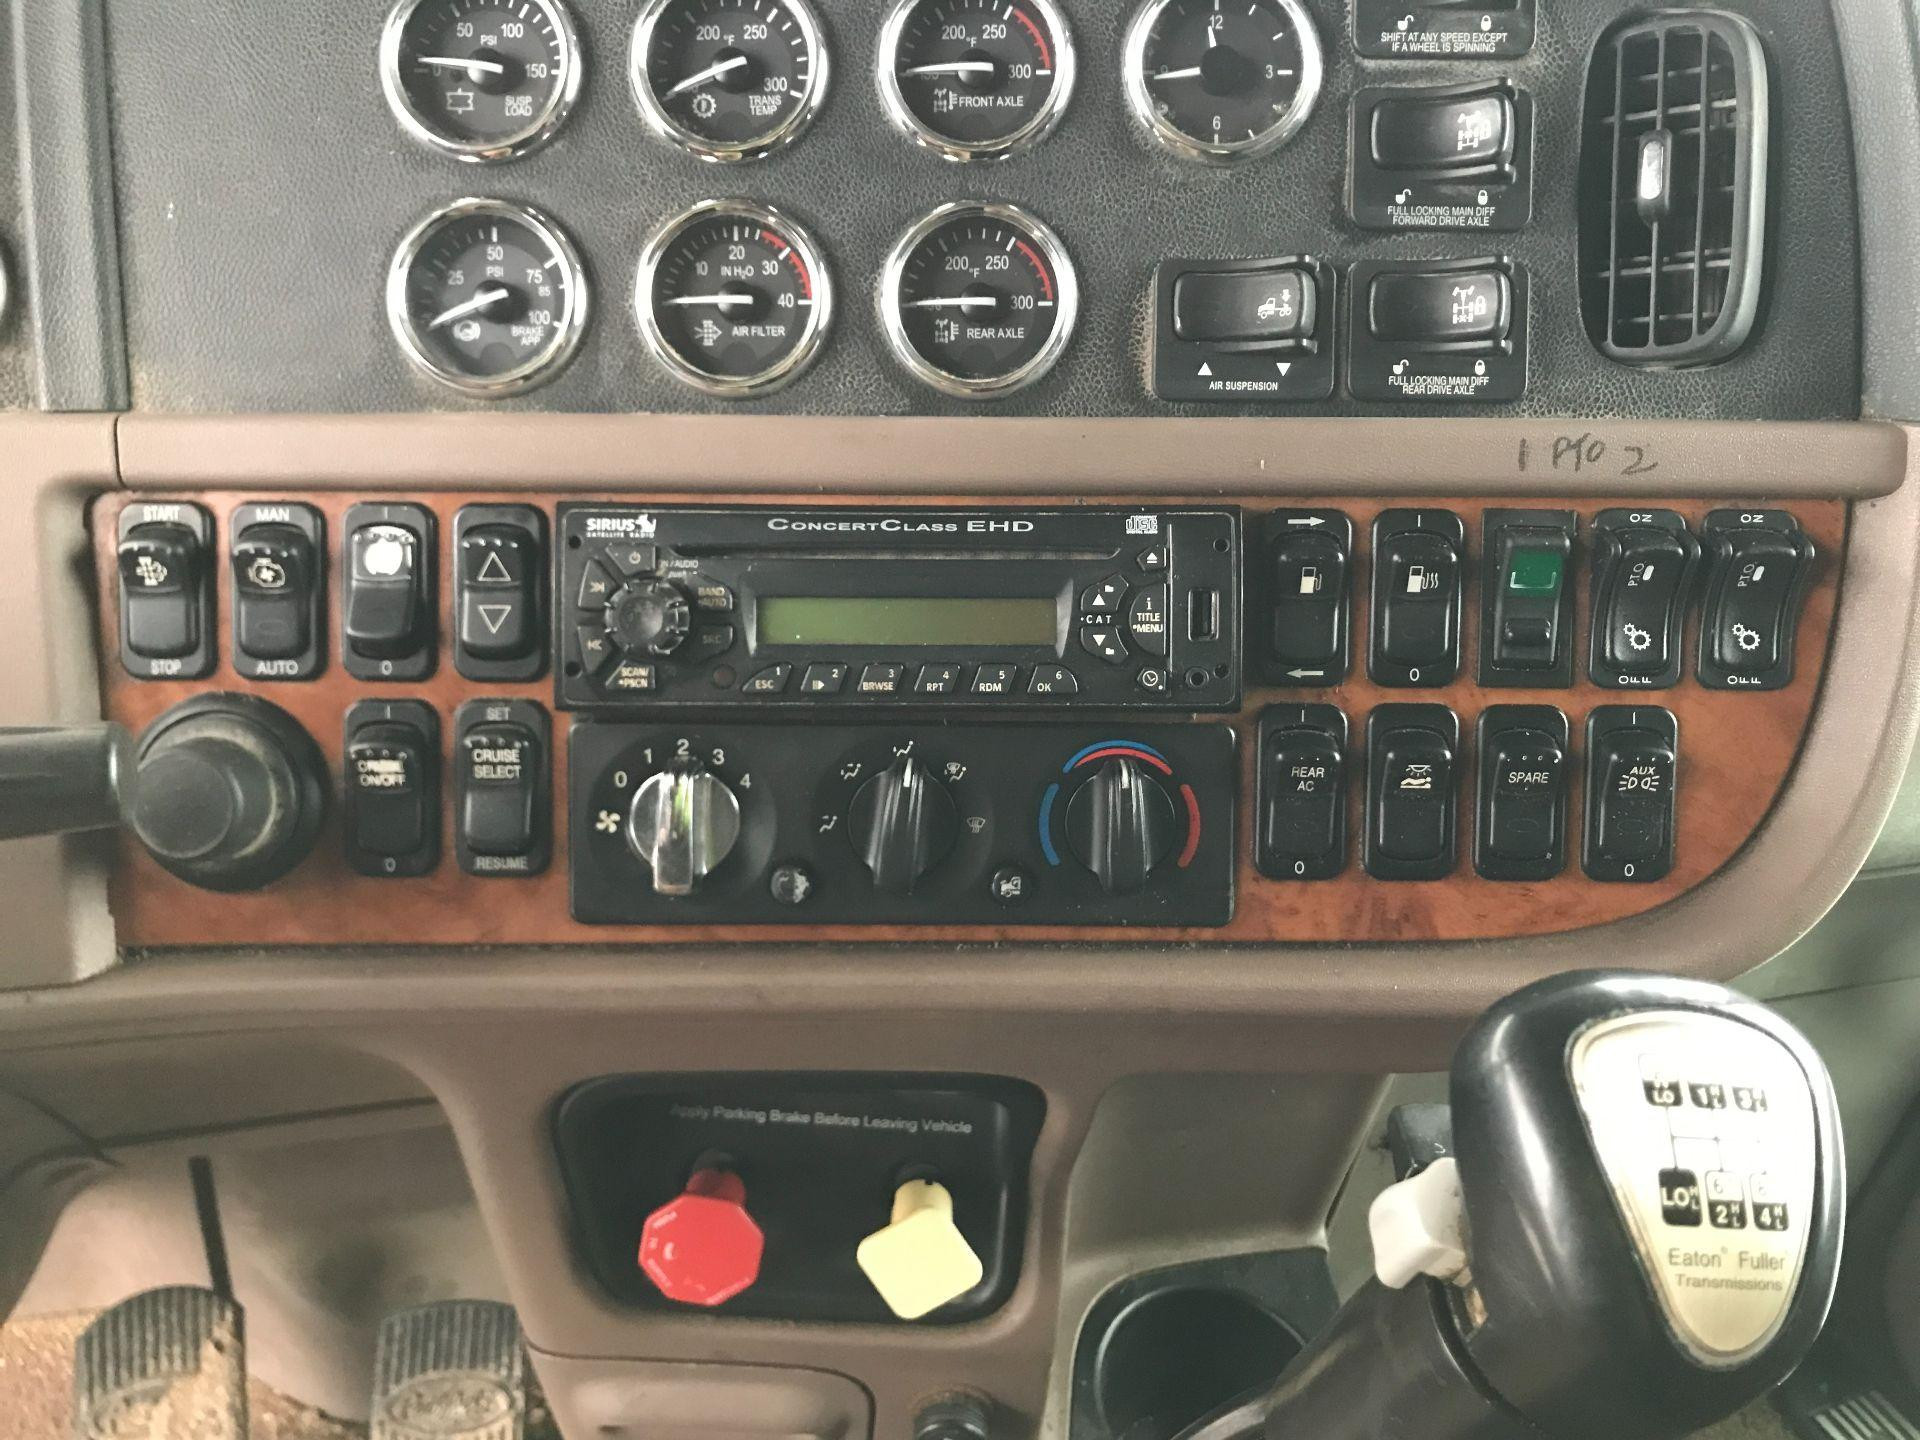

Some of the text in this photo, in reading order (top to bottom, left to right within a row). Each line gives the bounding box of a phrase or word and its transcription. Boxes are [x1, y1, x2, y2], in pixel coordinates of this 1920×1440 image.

[1210, 15, 1223, 30] 12
[456, 22, 473, 38] 50
[501, 23, 523, 38] 100
[696, 25, 720, 41] 200
[743, 25, 767, 40] 250
[941, 25, 965, 40] 200
[982, 25, 1006, 39] 250
[480, 35, 497, 46] PSI
[1381, 32, 1507, 43] SHIFT AT ANY SPEED EXCEPT
[1392, 43, 1496, 53] IF A WHEEL IS SPINNING
[525, 64, 546, 78] 150
[1008, 64, 1031, 79] 300
[1265, 65, 1274, 79] 3
[764, 77, 787, 92] 300
[505, 96, 532, 106] SUSP
[749, 95, 782, 106] TRANS
[959, 96, 1024, 107] FRONT AXLE
[505, 106, 532, 117] LOAD
[750, 105, 777, 116] TEMP
[1212, 116, 1221, 130] 6
[1388, 206, 1495, 216] FULL LOCKING MAIN DIFF
[1392, 216, 1489, 226] FORWARD DRIVE AXLE
[486, 247, 503, 261] 50
[728, 246, 745, 260] 20
[696, 261, 708, 275] 10
[762, 261, 778, 275] 30
[945, 256, 968, 270] 200
[986, 256, 1009, 270] 250
[448, 270, 464, 285] 25
[486, 266, 503, 277] PSI
[526, 269, 542, 284] 75
[721, 266, 731, 276] IN
[778, 293, 794, 308] 40
[1010, 295, 1033, 309] 300
[529, 311, 550, 325] 100
[511, 326, 544, 336] BRAKE
[732, 326, 785, 336] AIR FILTER
[967, 328, 1024, 339] REAR AXLE
[521, 336, 540, 345] APP
[1209, 381, 1278, 391] AIR SUSPENSION
[1388, 376, 1489, 386] FULL LOCKING MAIN DIFF
[1402, 385, 1475, 395] REAR DRIVE AXLE
[1620, 446, 1658, 475] 2
[143, 506, 180, 521] START
[256, 508, 289, 522] MAN
[586, 518, 635, 531] SIRIUS
[967, 521, 1034, 532] EHD
[1137, 613, 1160, 622] TITLE
[150, 659, 182, 674] STOP
[256, 660, 299, 675] AUTO
[775, 667, 781, 676] 1
[832, 669, 839, 678] 2
[888, 669, 895, 678] 3
[942, 670, 949, 679] 4
[998, 670, 1005, 680] 5
[1055, 671, 1062, 680] 6
[1618, 675, 1652, 684] OFF
[1727, 675, 1762, 685] OFF
[755, 680, 774, 690] ESC
[862, 682, 894, 692] BRWSE
[926, 682, 944, 692] RPT
[979, 682, 1002, 692] RDM
[1037, 682, 1052, 692] OK
[486, 706, 511, 721] SET
[677, 738, 690, 755] 2
[473, 749, 520, 763] CRUISE
[644, 748, 652, 764] 1
[712, 749, 725, 765] 3
[473, 765, 521, 779] SELECT
[1291, 767, 1325, 778] REAR
[1630, 766, 1656, 775] AUX
[614, 771, 628, 788] 0
[740, 773, 751, 789] 4
[1508, 772, 1549, 784] SPARE
[1297, 781, 1314, 792] AC
[475, 857, 528, 870] RESUME
[712, 1105, 767, 1123] Parking
[769, 1109, 811, 1124] Brake
[813, 1112, 860, 1127] Before
[863, 1115, 918, 1132] Leaving
[921, 1118, 972, 1133] Vehicle
[1716, 1205, 1728, 1224] 2
[1761, 1207, 1771, 1226] 4
[1738, 1251, 1785, 1270] Fuller
[1675, 1274, 1783, 1292] Transmissions
